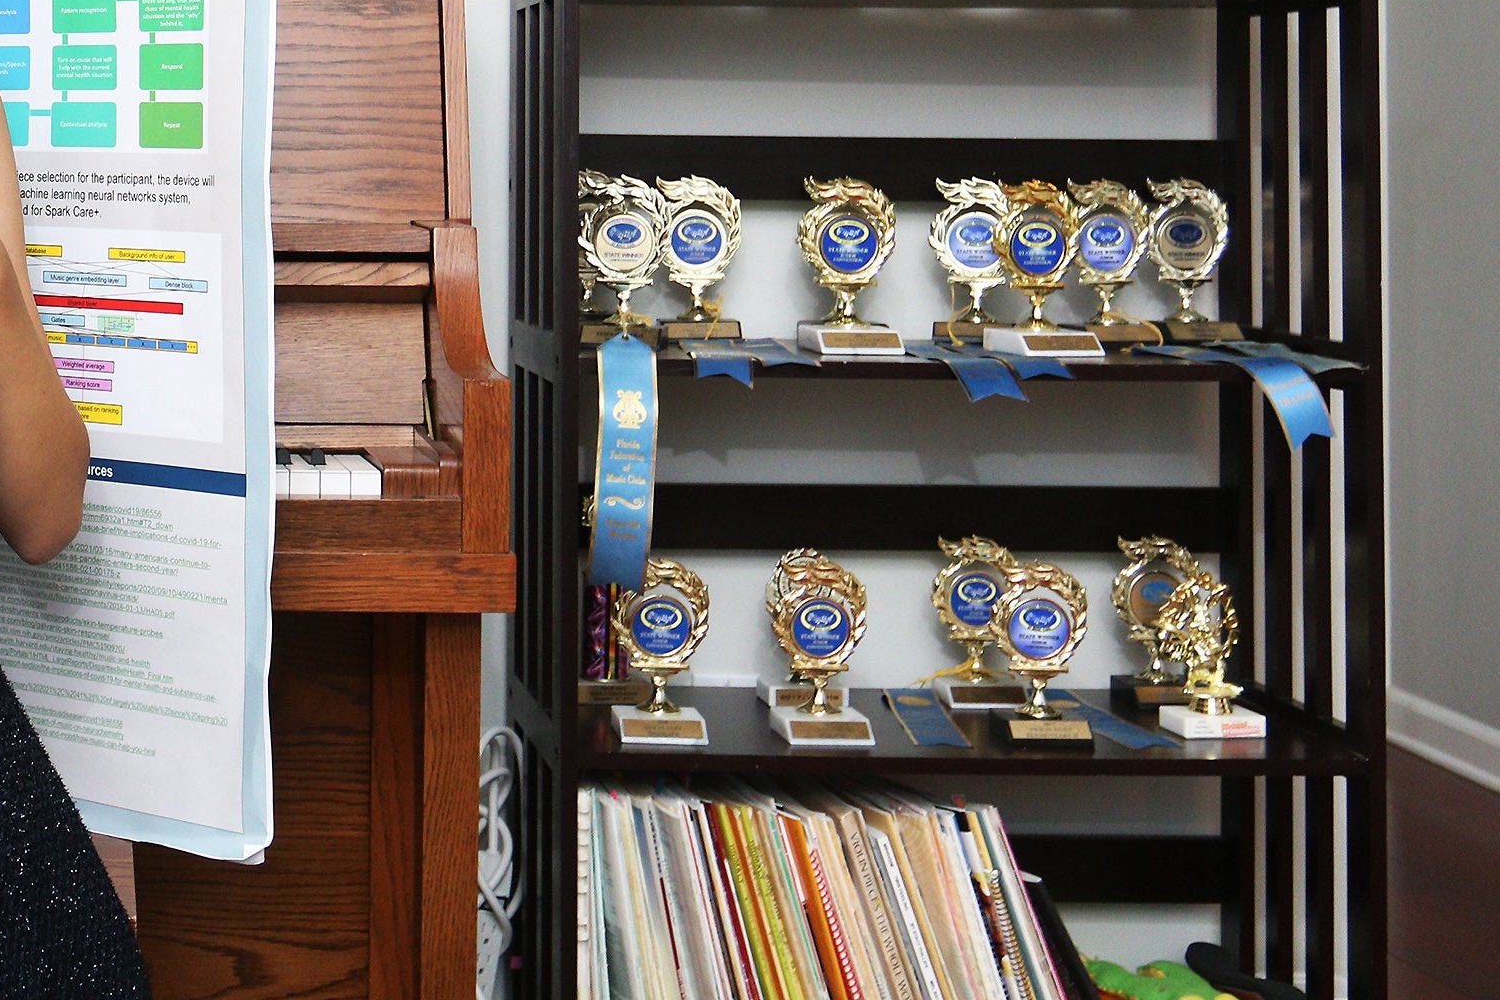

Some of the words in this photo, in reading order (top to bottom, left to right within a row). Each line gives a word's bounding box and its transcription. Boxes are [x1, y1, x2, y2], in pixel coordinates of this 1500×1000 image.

[66, 380, 86, 388] Ranking
[850, 832, 868, 872] VIOLIN
[876, 915, 888, 934] THE
[884, 936, 903, 976] WHOLE
